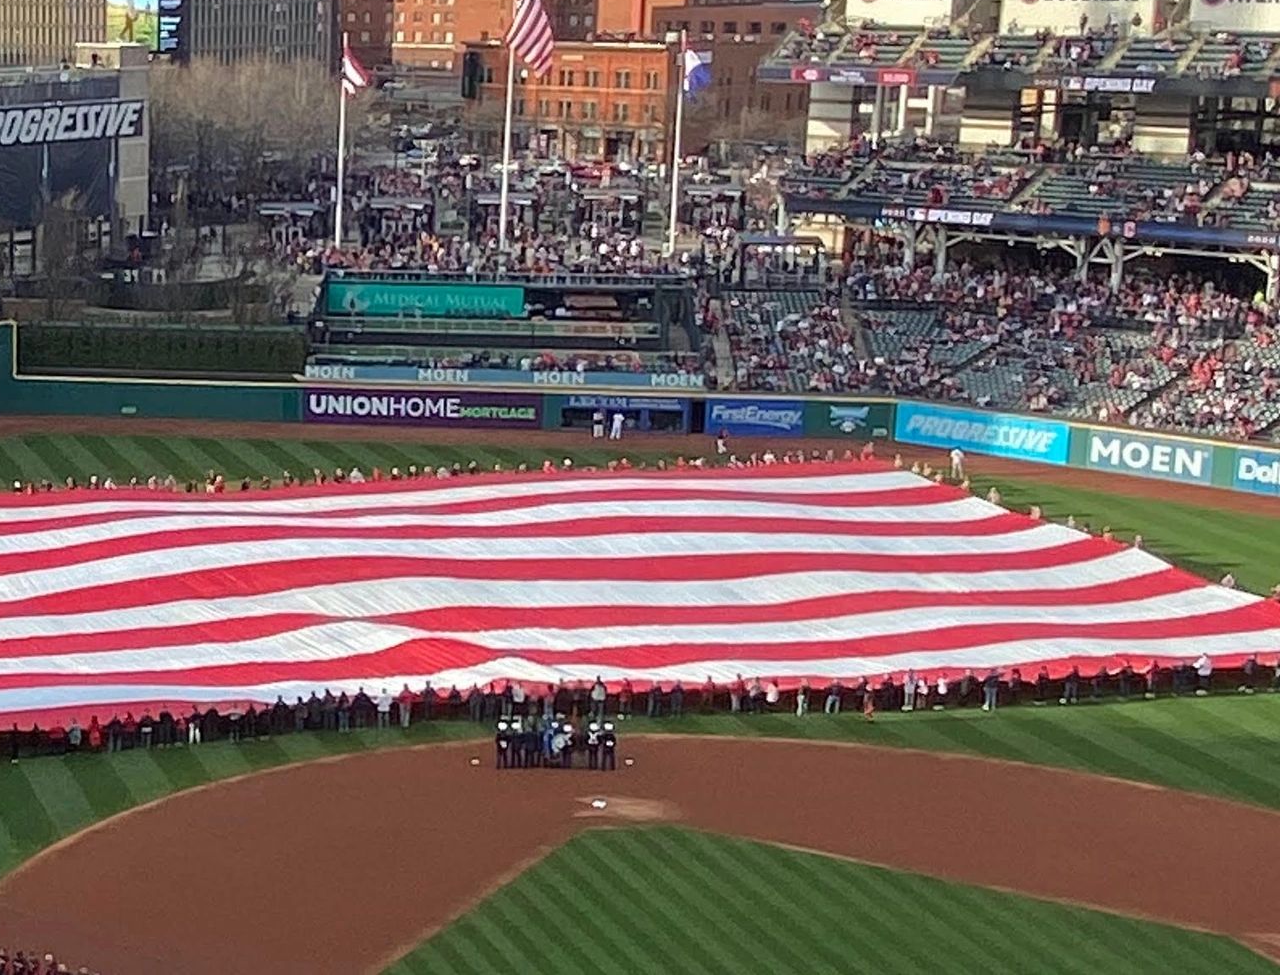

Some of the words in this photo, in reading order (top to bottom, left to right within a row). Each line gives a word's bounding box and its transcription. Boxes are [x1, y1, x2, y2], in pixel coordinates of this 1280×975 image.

[447, 294, 508, 308] MUTUAL
[304, 365, 356, 380] MOEN
[418, 368, 469, 383] MOEN
[533, 371, 585, 385] MOEN
[651, 373, 705, 387] MOEN
[309, 394, 461, 418] UNIONHOME
[460, 406, 536, 419] MORTGAGE
[711, 404, 803, 425] FirstEnergy
[905, 414, 1058, 453] PROGRESSIVE
[1090, 436, 1203, 477] MOEN
[1238, 457, 1280, 485] Dol
